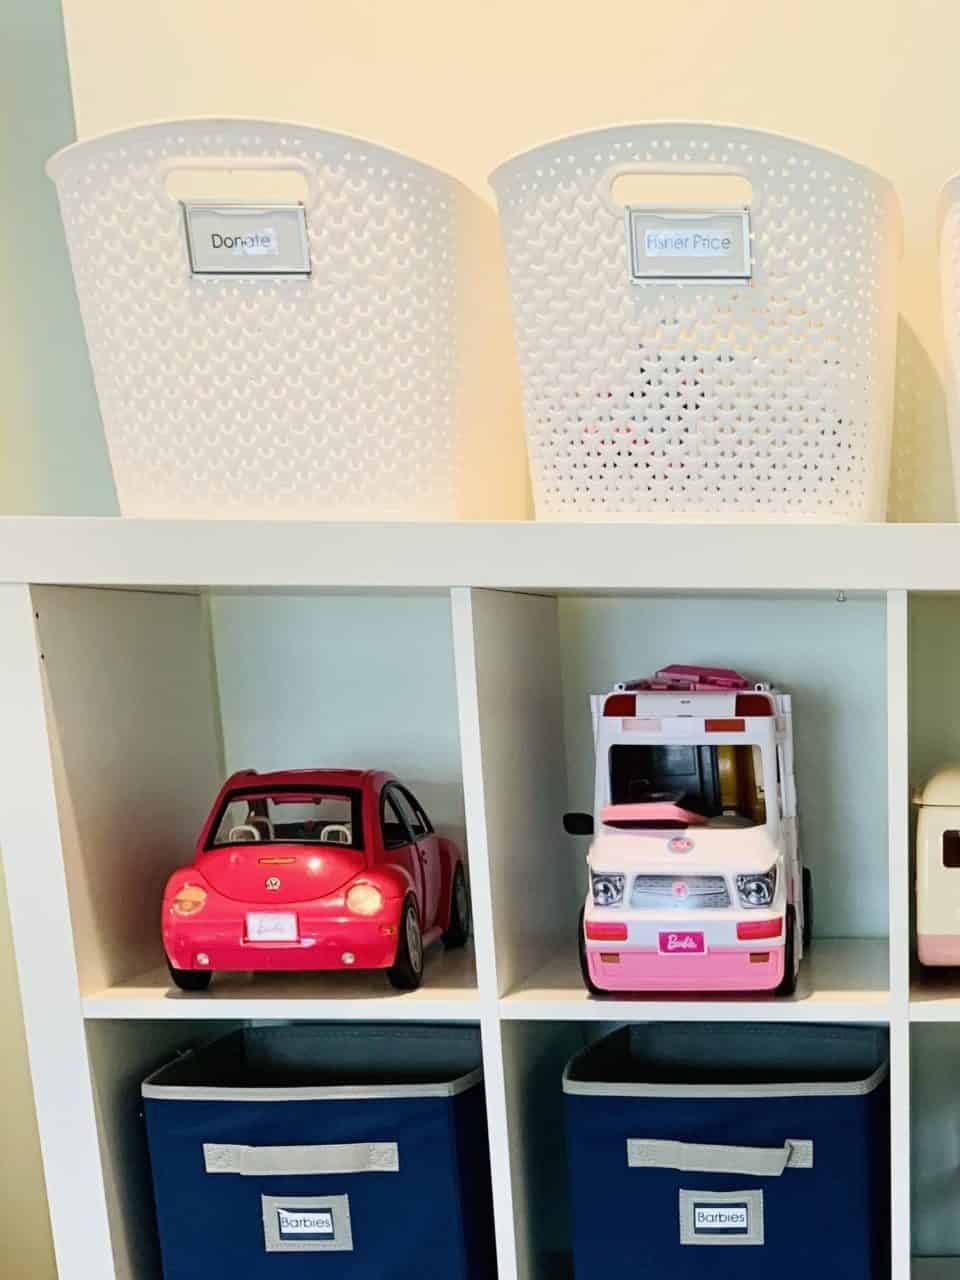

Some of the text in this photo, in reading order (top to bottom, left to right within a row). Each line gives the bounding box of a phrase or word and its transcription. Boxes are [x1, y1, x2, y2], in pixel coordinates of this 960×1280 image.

[211, 233, 271, 249] Donate
[692, 233, 731, 249] Price
[281, 1216, 330, 1228] Barbies
[697, 1211, 745, 1223] Barbies
